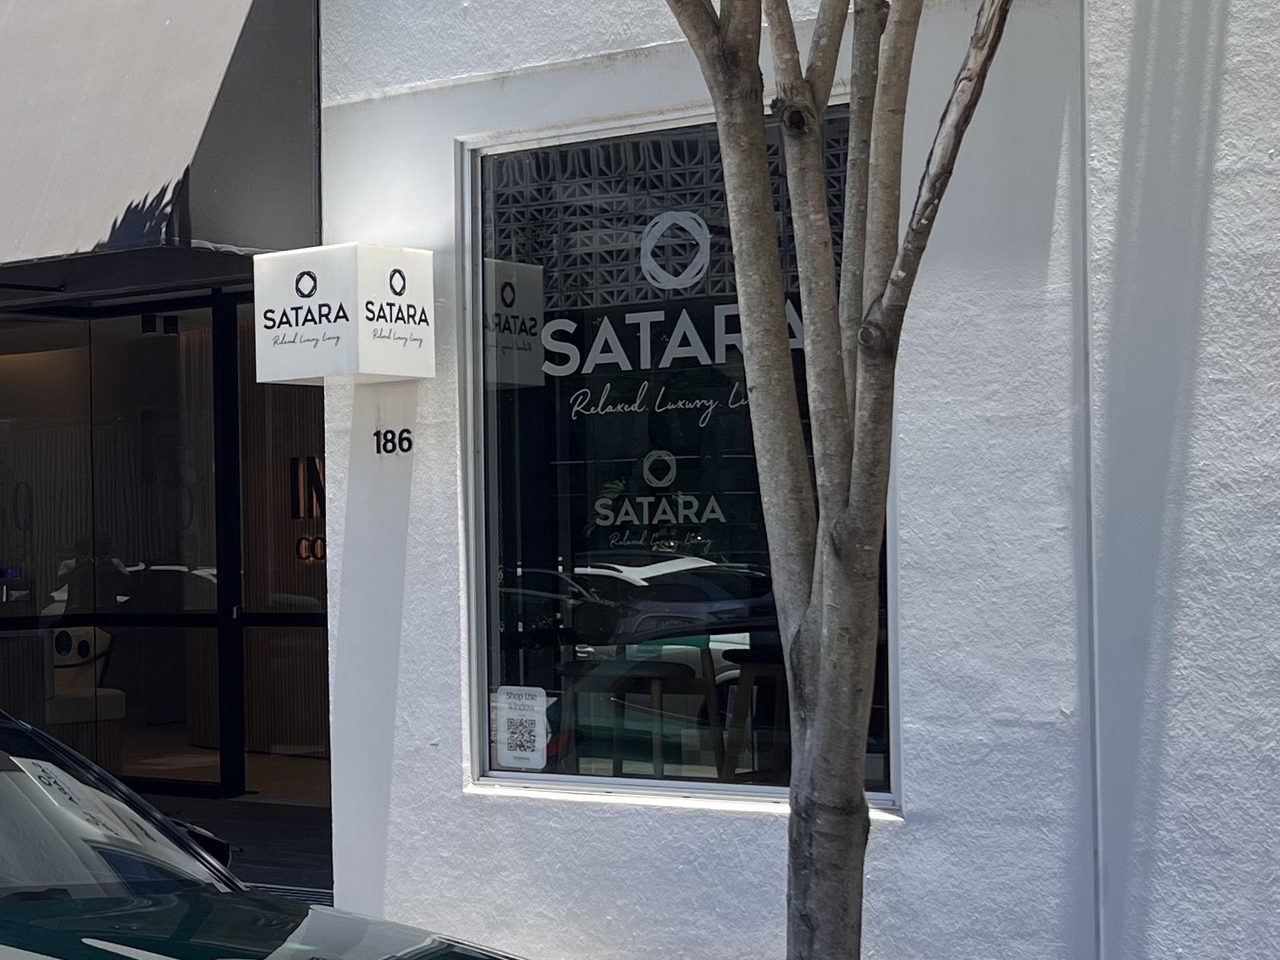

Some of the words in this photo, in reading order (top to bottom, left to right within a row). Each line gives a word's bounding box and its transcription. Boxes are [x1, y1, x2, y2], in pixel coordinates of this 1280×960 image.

[263, 302, 350, 330] SATARA
[365, 300, 430, 327] SATARA
[373, 428, 413, 454] 186
[594, 494, 727, 527] SATARA
